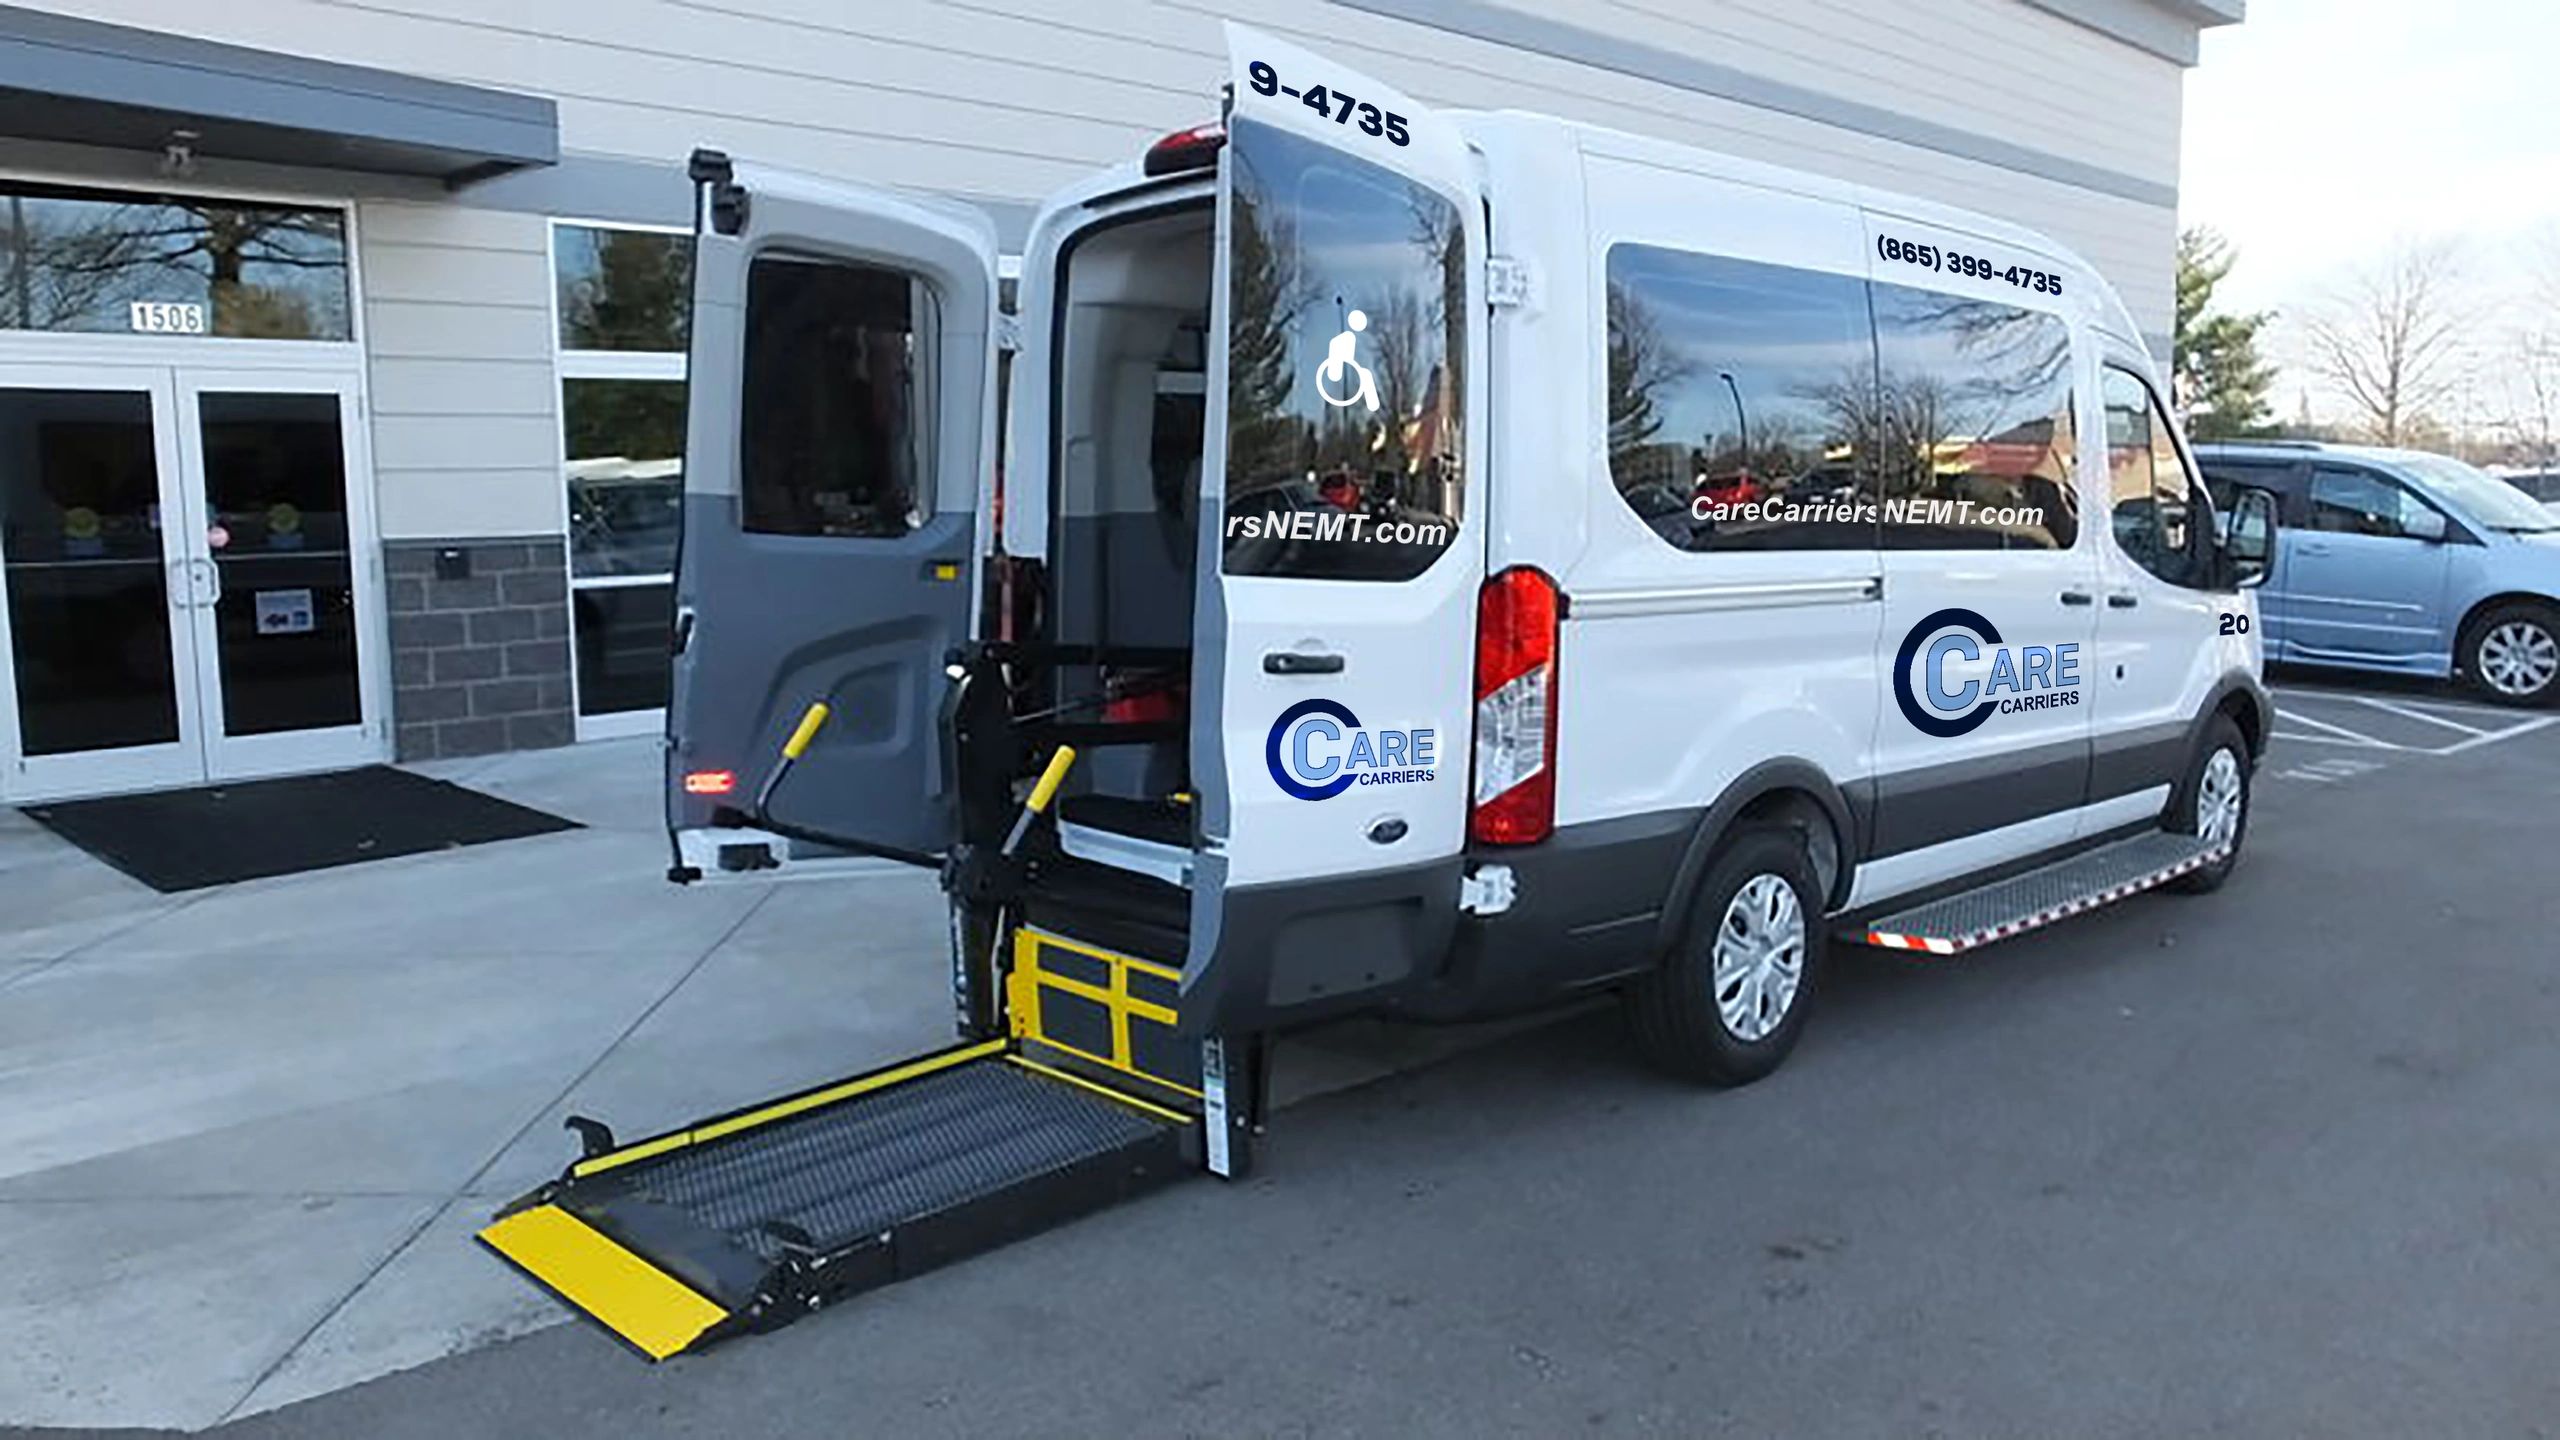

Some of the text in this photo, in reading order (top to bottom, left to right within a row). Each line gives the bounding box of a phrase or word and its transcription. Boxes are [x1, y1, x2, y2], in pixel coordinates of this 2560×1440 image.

[1249, 60, 1410, 147] 9-4735
[1877, 233, 2063, 296] (865) 399-4735
[138, 306, 199, 330] 1506
[1226, 510, 1447, 546] rsNEMT.com
[2219, 613, 2250, 636] 20
[2001, 691, 2079, 715] CARRIERS
[1360, 769, 1435, 786] CARRIERS
